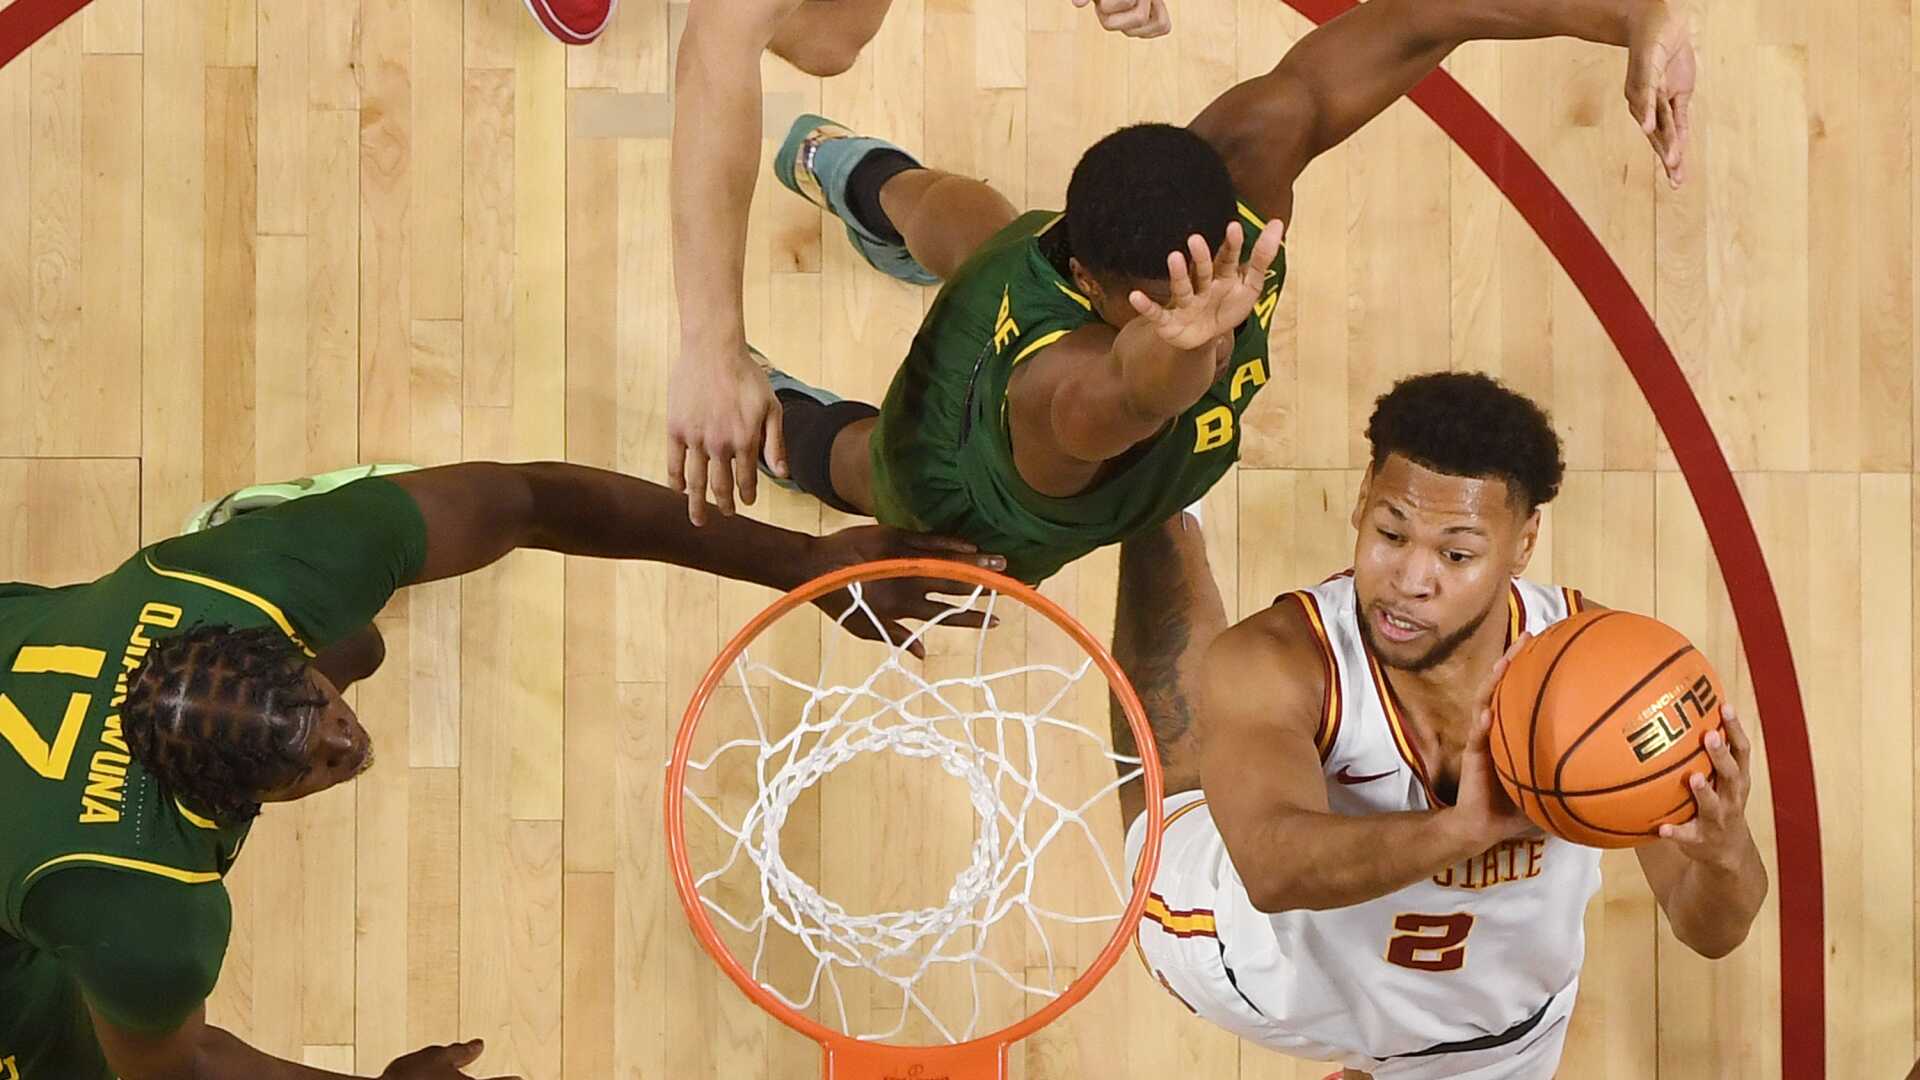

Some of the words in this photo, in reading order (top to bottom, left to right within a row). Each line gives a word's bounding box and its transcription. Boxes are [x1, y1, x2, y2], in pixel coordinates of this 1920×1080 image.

[0, 644, 107, 780] 17
[1625, 673, 1717, 763] ELITE
[1384, 911, 1476, 973] 2
